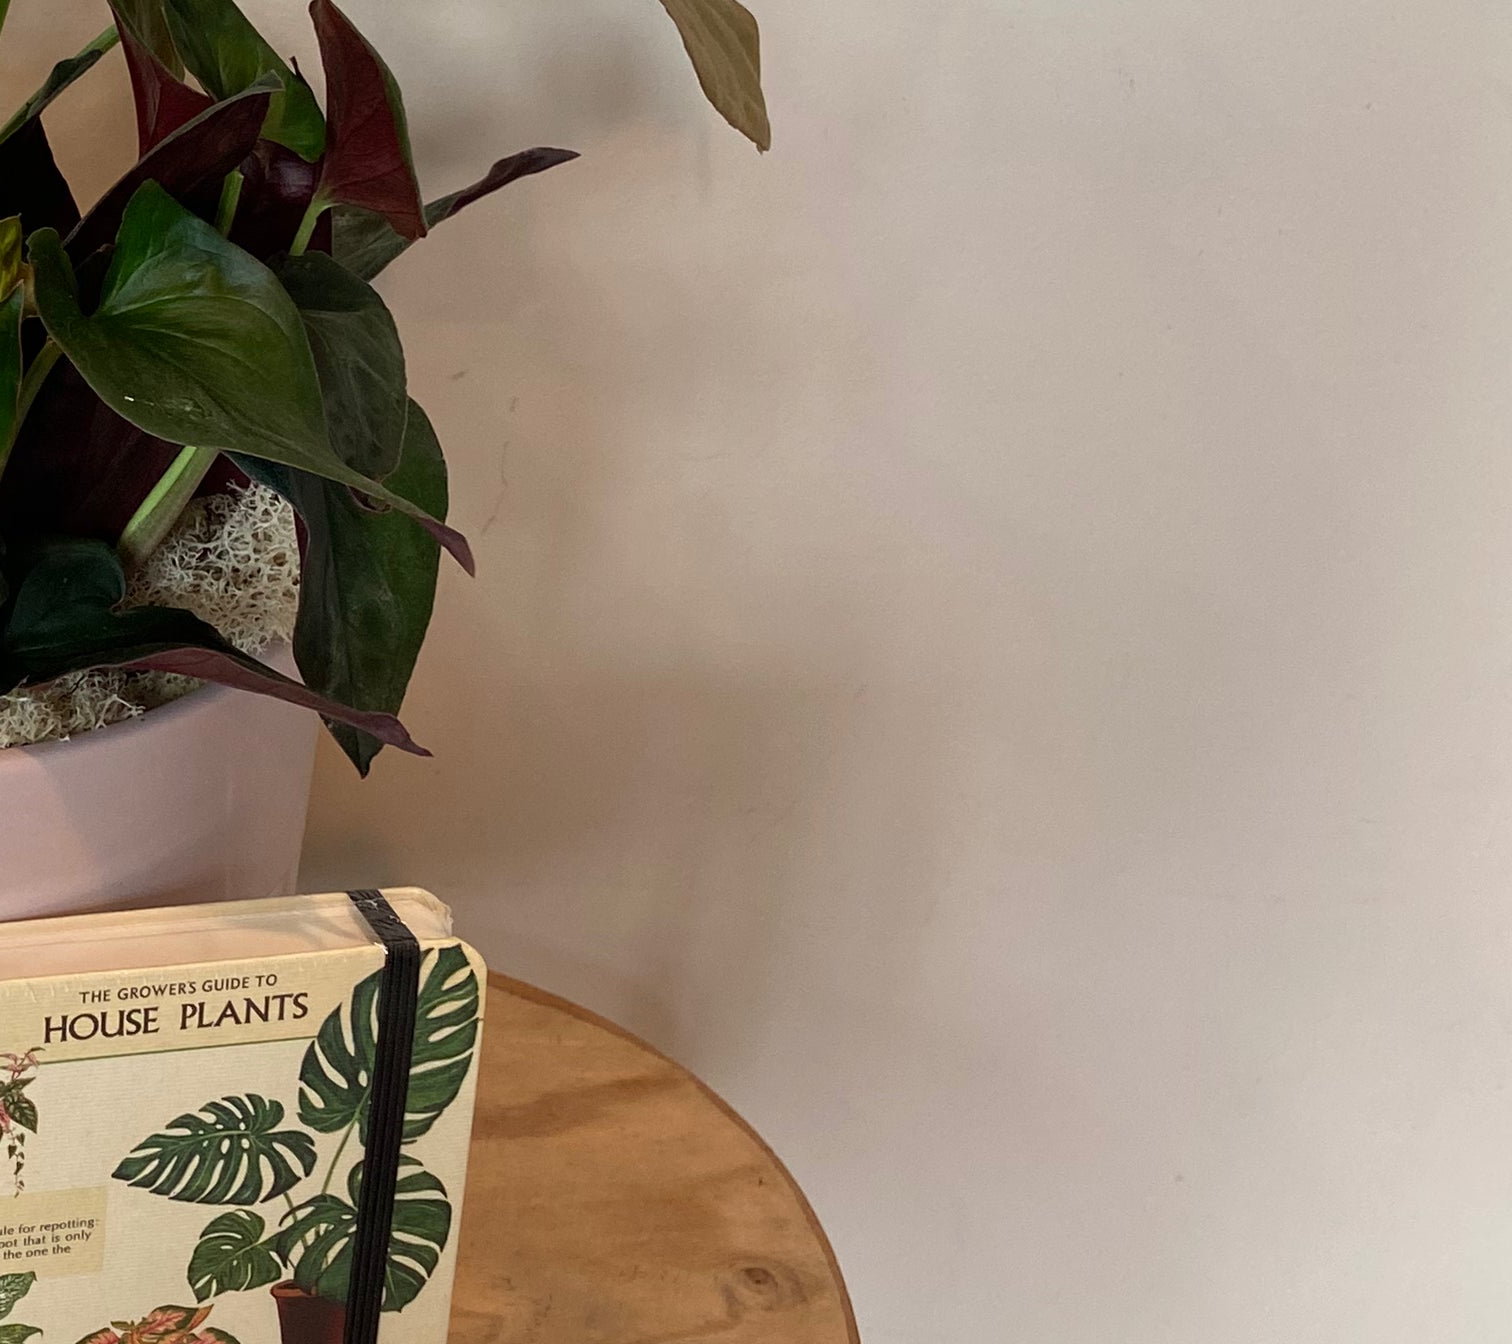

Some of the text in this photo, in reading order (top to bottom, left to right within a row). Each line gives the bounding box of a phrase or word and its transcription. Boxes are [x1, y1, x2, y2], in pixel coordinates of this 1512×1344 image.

[79, 990, 111, 1004] THE
[201, 976, 250, 993] GUIDE
[255, 974, 278, 987] TO
[44, 992, 309, 1044] HOUSE PLANTS
[18, 1224, 36, 1234] for
[23, 1235, 46, 1246] that
[51, 1233, 61, 1243] is
[65, 1229, 92, 1242] only
[3, 1249, 22, 1260] the
[26, 1248, 48, 1258] one
[52, 1244, 71, 1254] the
